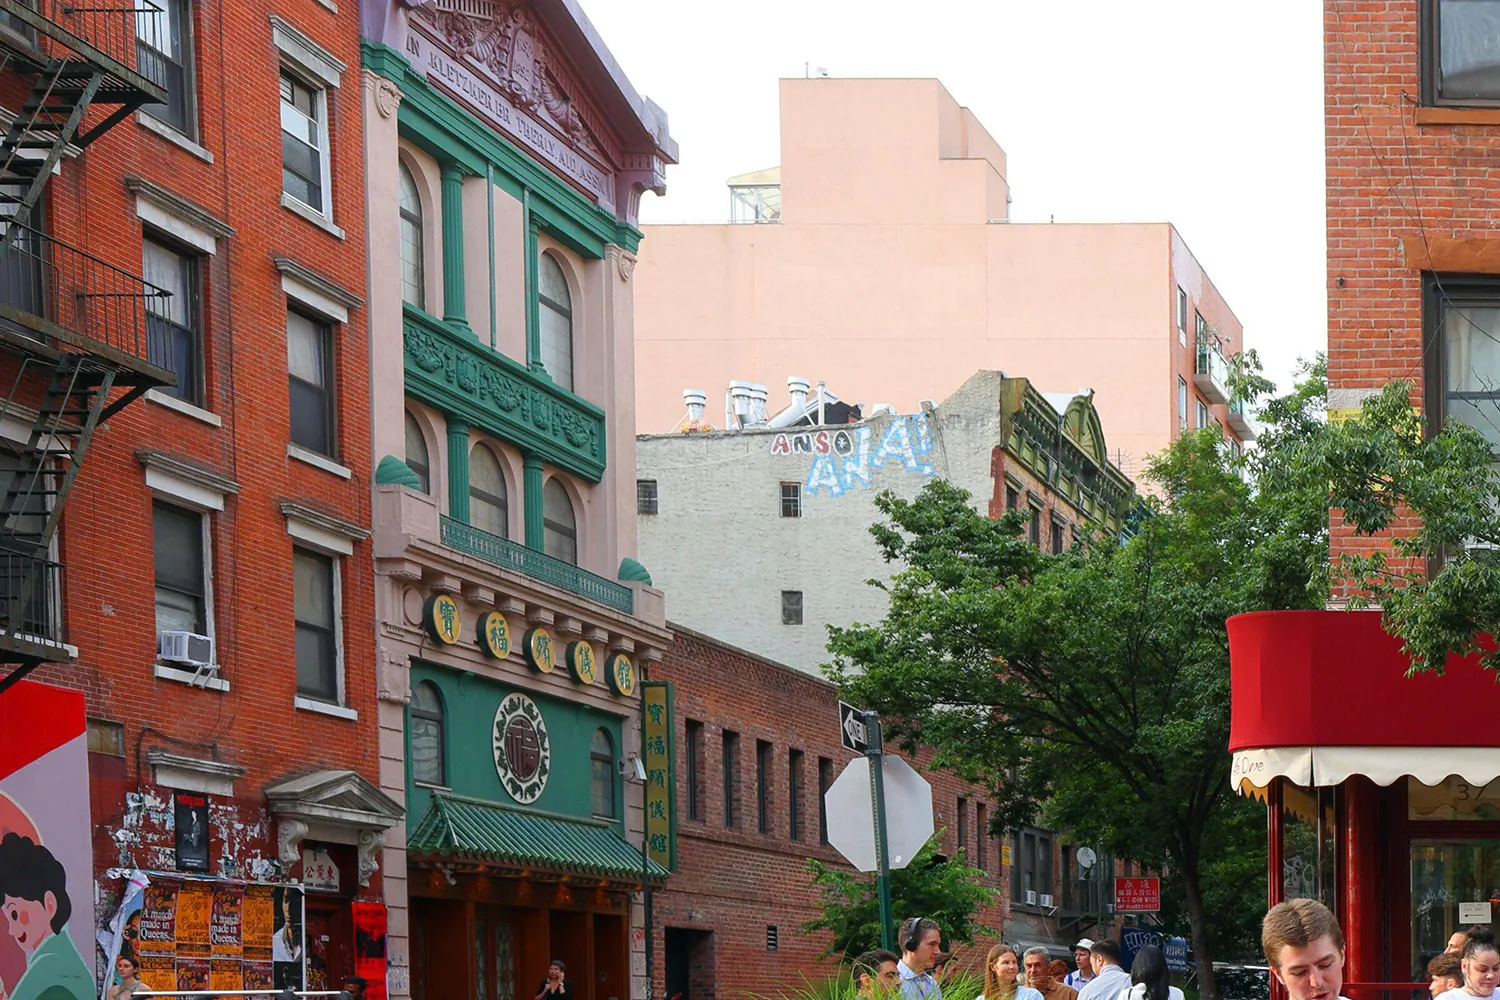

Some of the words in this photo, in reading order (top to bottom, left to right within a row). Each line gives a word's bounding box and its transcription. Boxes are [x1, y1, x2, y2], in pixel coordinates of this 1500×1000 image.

[848, 719, 862, 741] ONE
[141, 908, 149, 918] A
[151, 909, 173, 920] match
[211, 913, 217, 923] A
[219, 914, 239, 925] match
[140, 919, 161, 928] made
[162, 918, 170, 929] in
[211, 923, 230, 933] made
[230, 924, 237, 934] in
